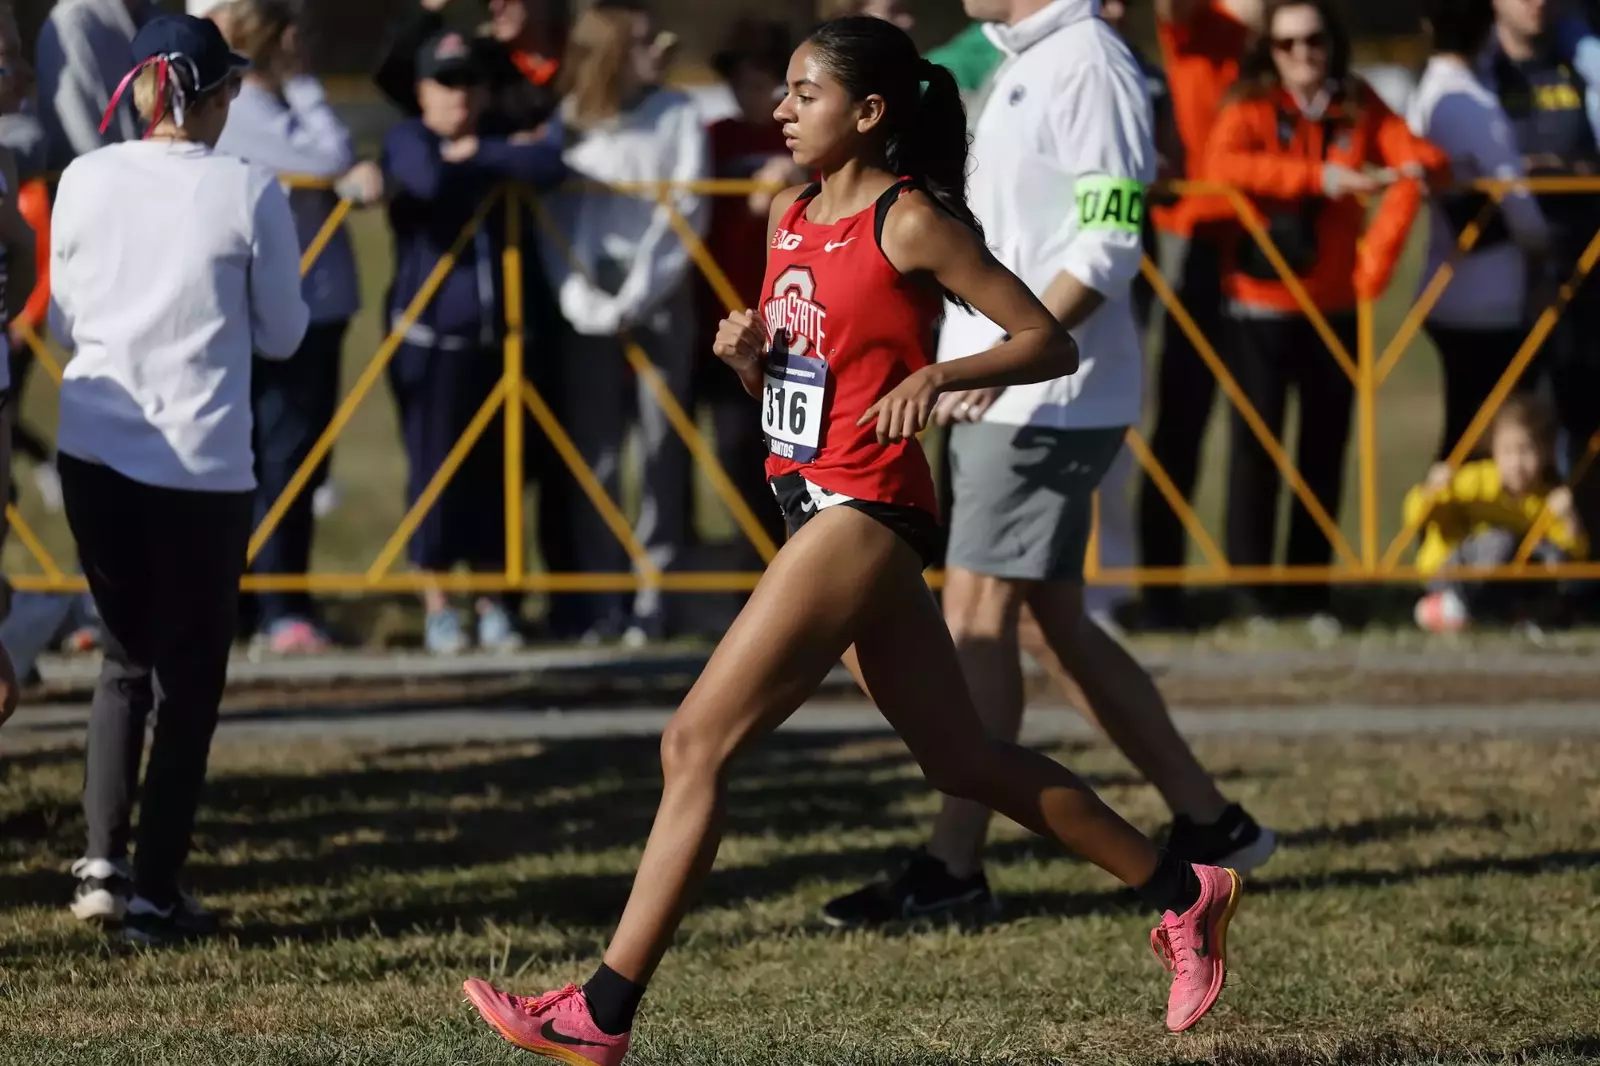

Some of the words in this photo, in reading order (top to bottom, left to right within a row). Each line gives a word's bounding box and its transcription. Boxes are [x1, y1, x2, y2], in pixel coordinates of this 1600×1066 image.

[785, 291, 827, 361] STATE
[766, 383, 808, 435] 316
[771, 438, 794, 459] SANTOS
